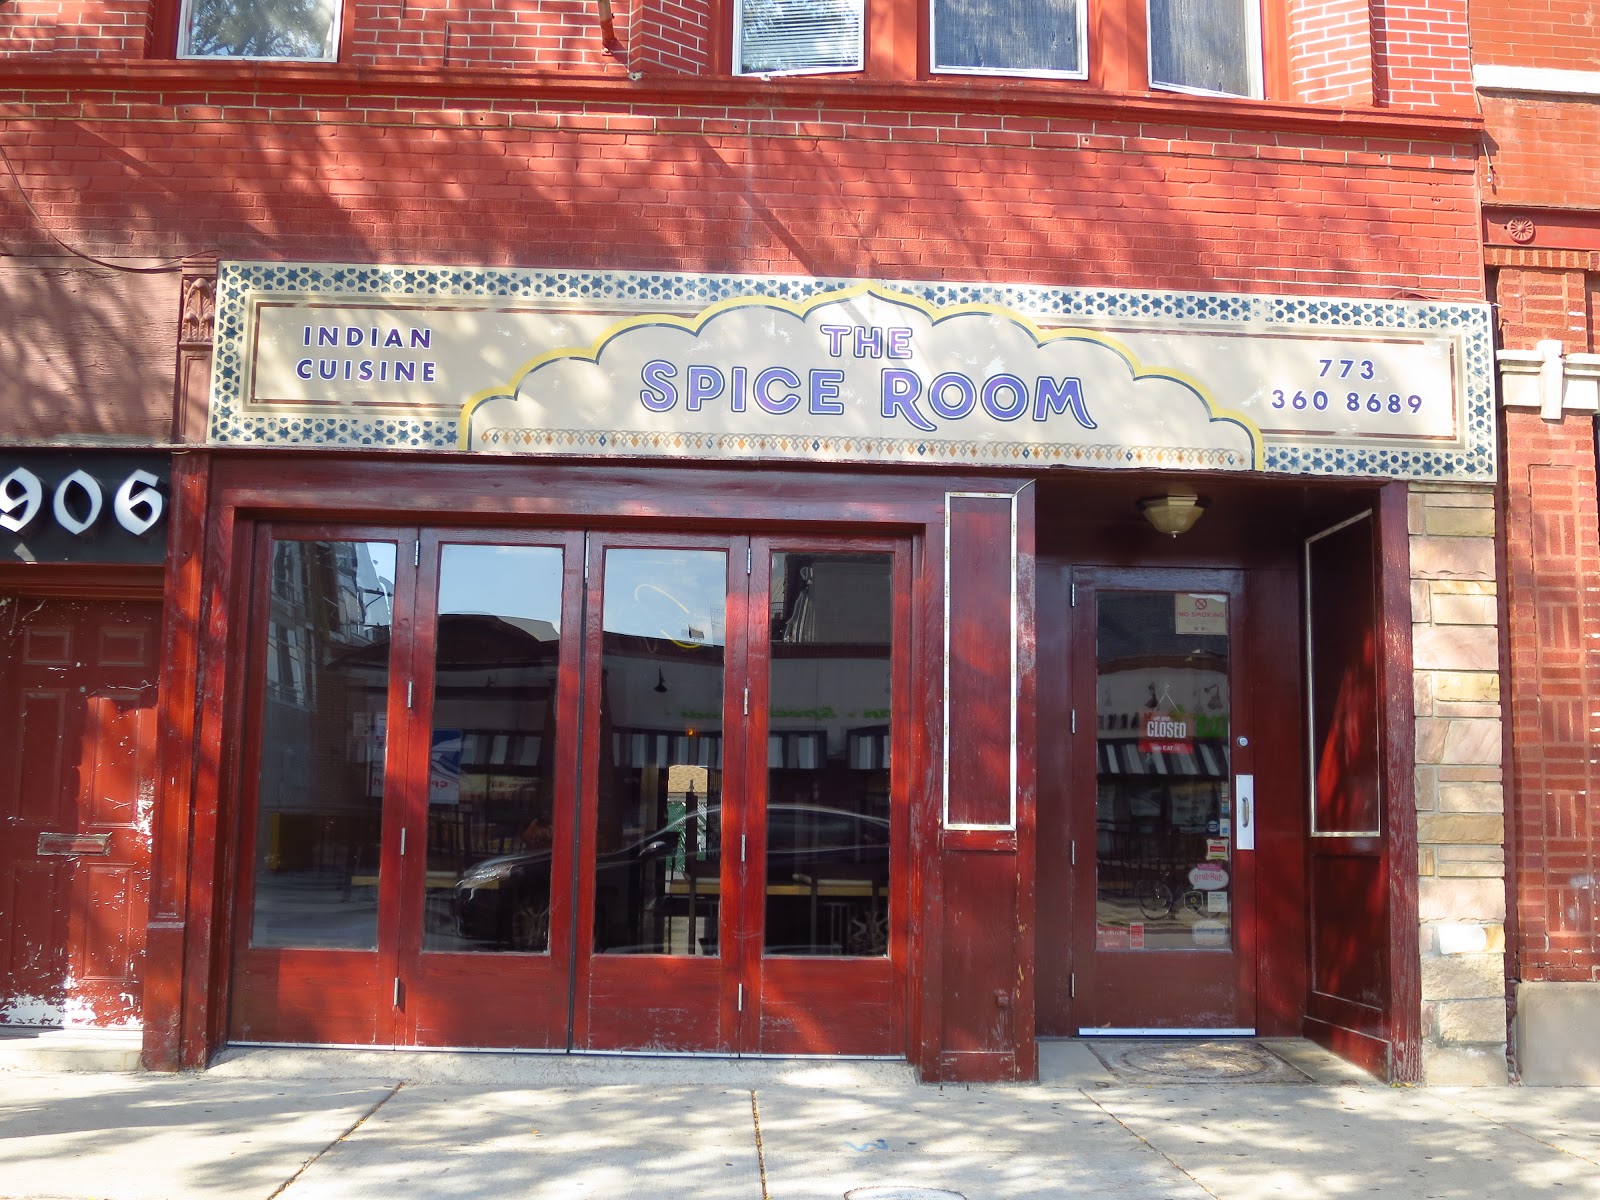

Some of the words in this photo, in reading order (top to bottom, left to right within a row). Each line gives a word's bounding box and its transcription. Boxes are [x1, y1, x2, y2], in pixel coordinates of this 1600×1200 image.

[304, 326, 431, 349] INDIAN
[820, 325, 913, 360] THE
[296, 359, 435, 382] CUISINE
[1319, 359, 1374, 380] 773
[640, 359, 845, 415] SPICE
[881, 367, 1098, 433] ROOM
[1271, 389, 1328, 411] 360
[1346, 392, 1423, 414] 8689
[1147, 721, 1187, 739] CLOSED
